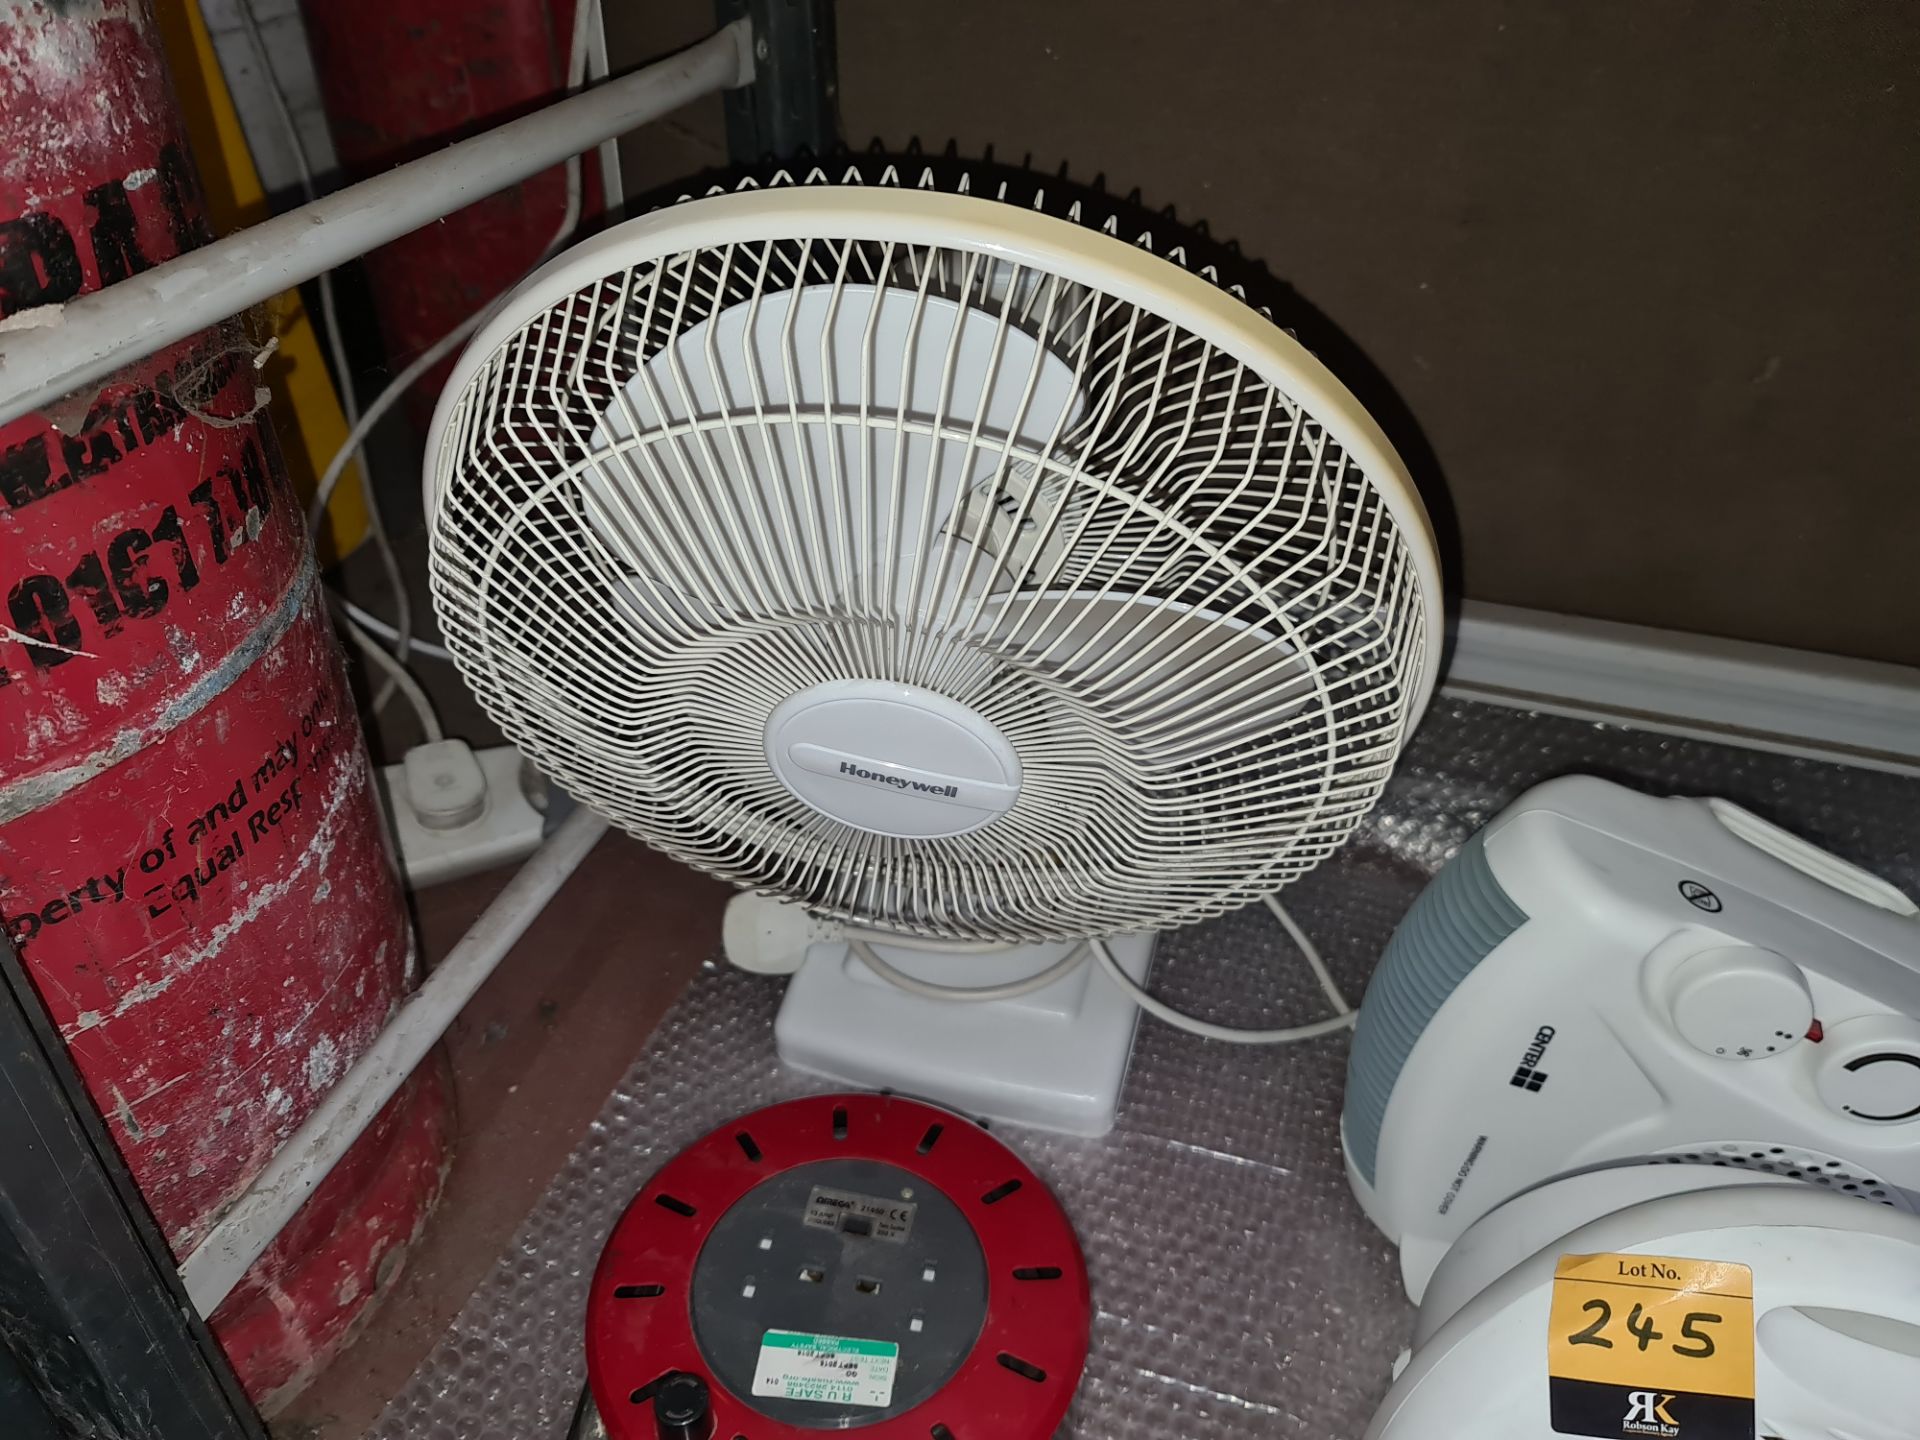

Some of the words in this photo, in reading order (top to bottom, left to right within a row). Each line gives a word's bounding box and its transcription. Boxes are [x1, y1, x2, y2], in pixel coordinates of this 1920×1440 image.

[840, 761, 959, 798] Honeywell
[139, 828, 177, 873] of
[187, 779, 248, 846] and
[251, 732, 298, 792] may
[144, 831, 246, 919] Equal
[1617, 1261, 1647, 1276] Lot
[1651, 1263, 1681, 1280] No.
[1568, 1299, 1722, 1358] 245
[785, 1387, 823, 1399] SAFE
[1623, 1420, 1660, 1432] Robson
[1660, 1424, 1680, 1437] Kay
